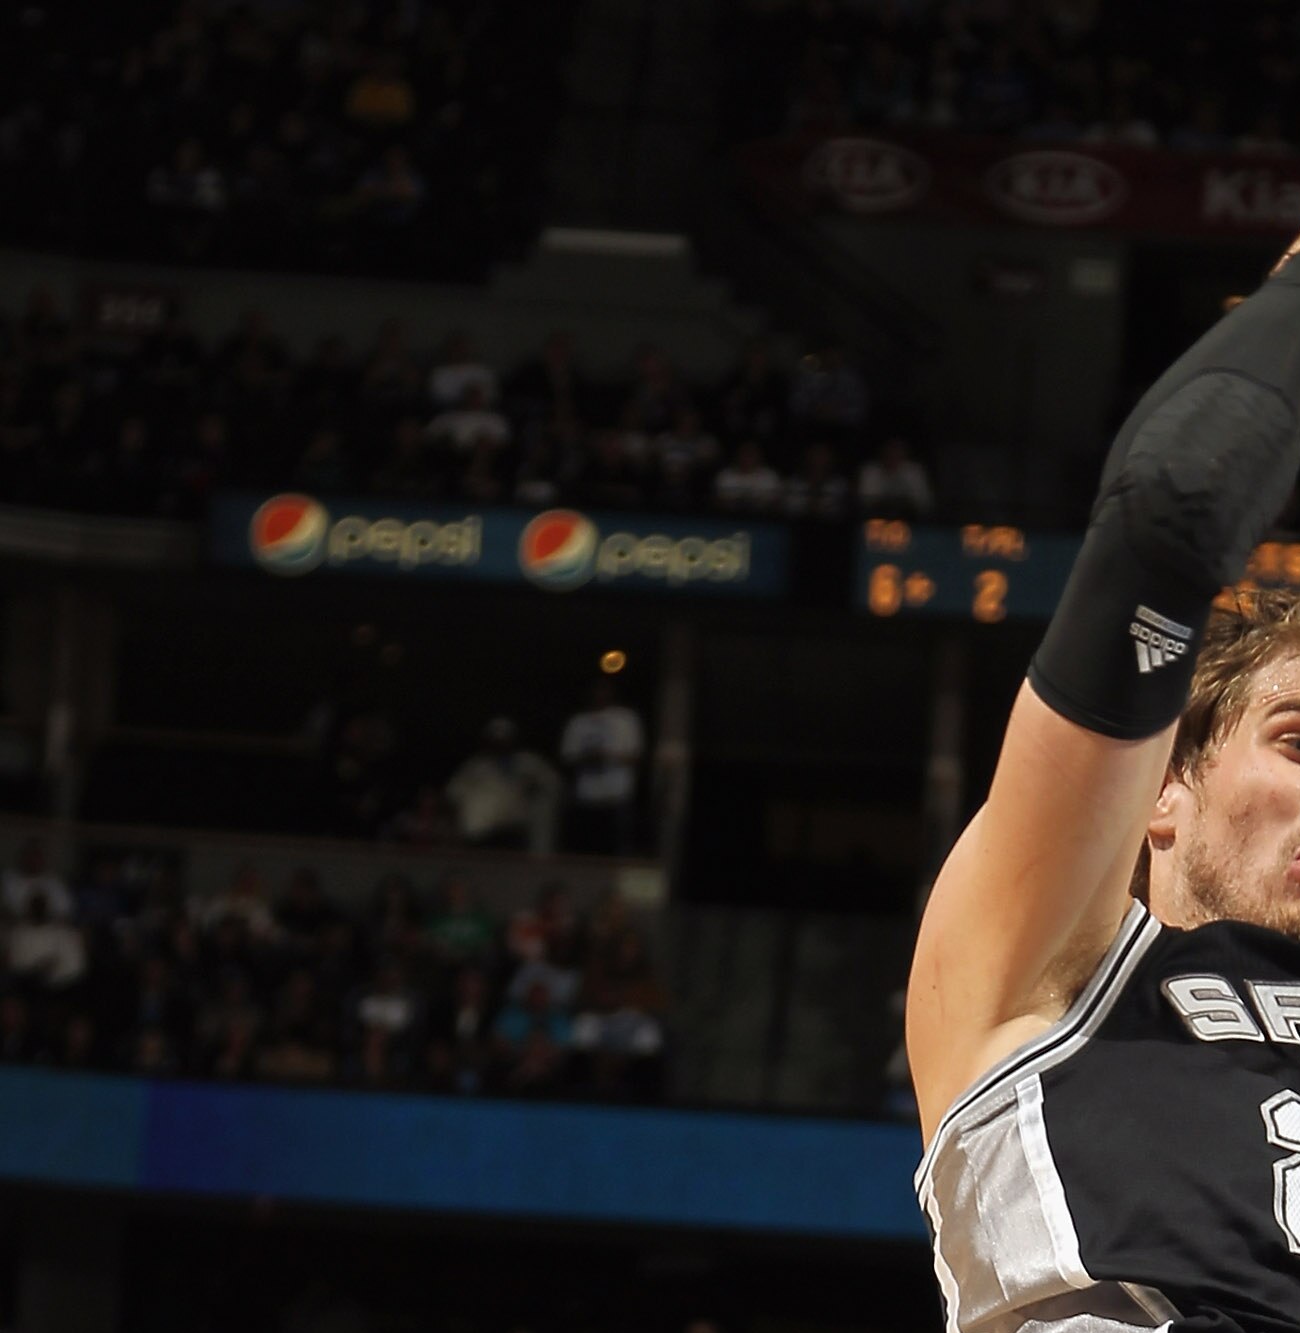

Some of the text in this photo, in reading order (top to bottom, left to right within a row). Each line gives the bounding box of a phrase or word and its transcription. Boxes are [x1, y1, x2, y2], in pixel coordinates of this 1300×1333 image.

[329, 514, 482, 572] pepsi
[597, 530, 750, 588] pepsi
[971, 569, 1009, 624] 2
[1129, 621, 1188, 655] adidas
